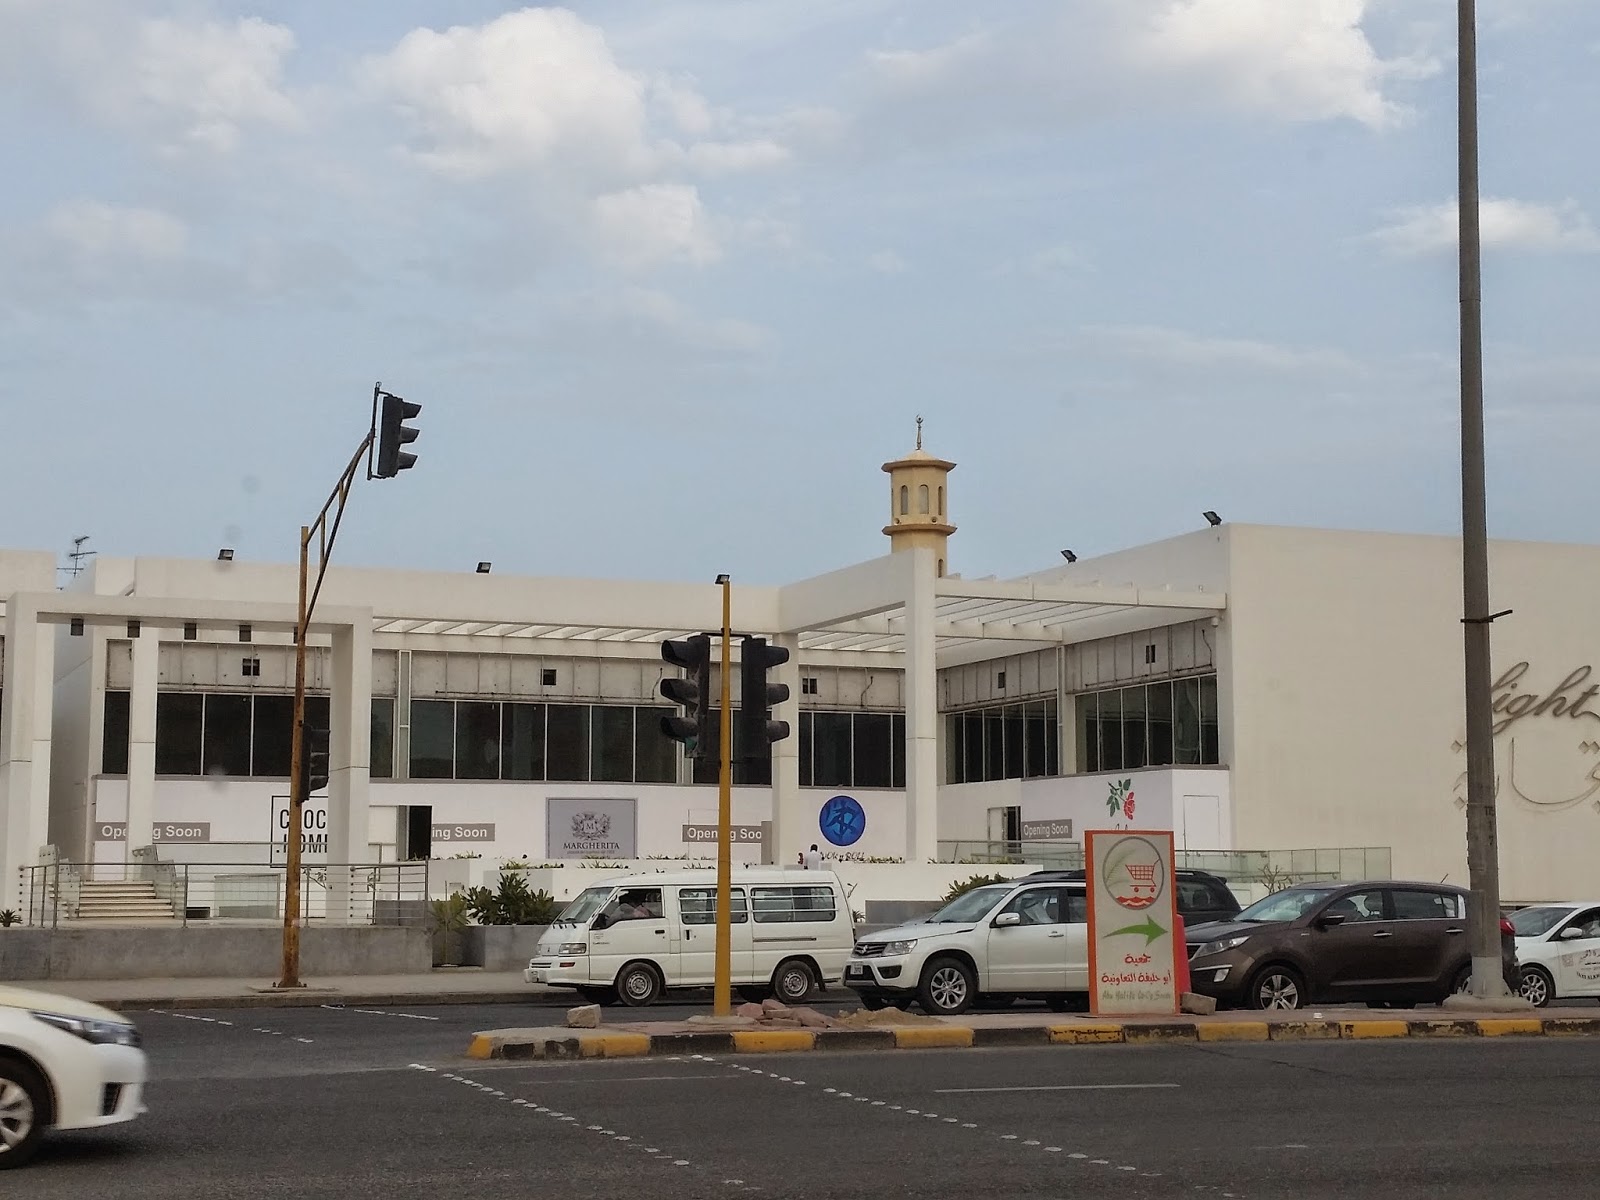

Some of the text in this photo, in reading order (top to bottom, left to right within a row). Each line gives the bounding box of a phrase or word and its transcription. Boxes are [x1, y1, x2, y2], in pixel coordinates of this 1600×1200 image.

[280, 809, 326, 829] COC
[165, 825, 202, 837] Soon
[454, 826, 487, 838] Soon
[688, 827, 762, 841] Openg Soo
[1023, 823, 1069, 838] Opening Soon
[563, 842, 620, 850] MARGHERITA
[1101, 972, 1137, 986] التعاونية
